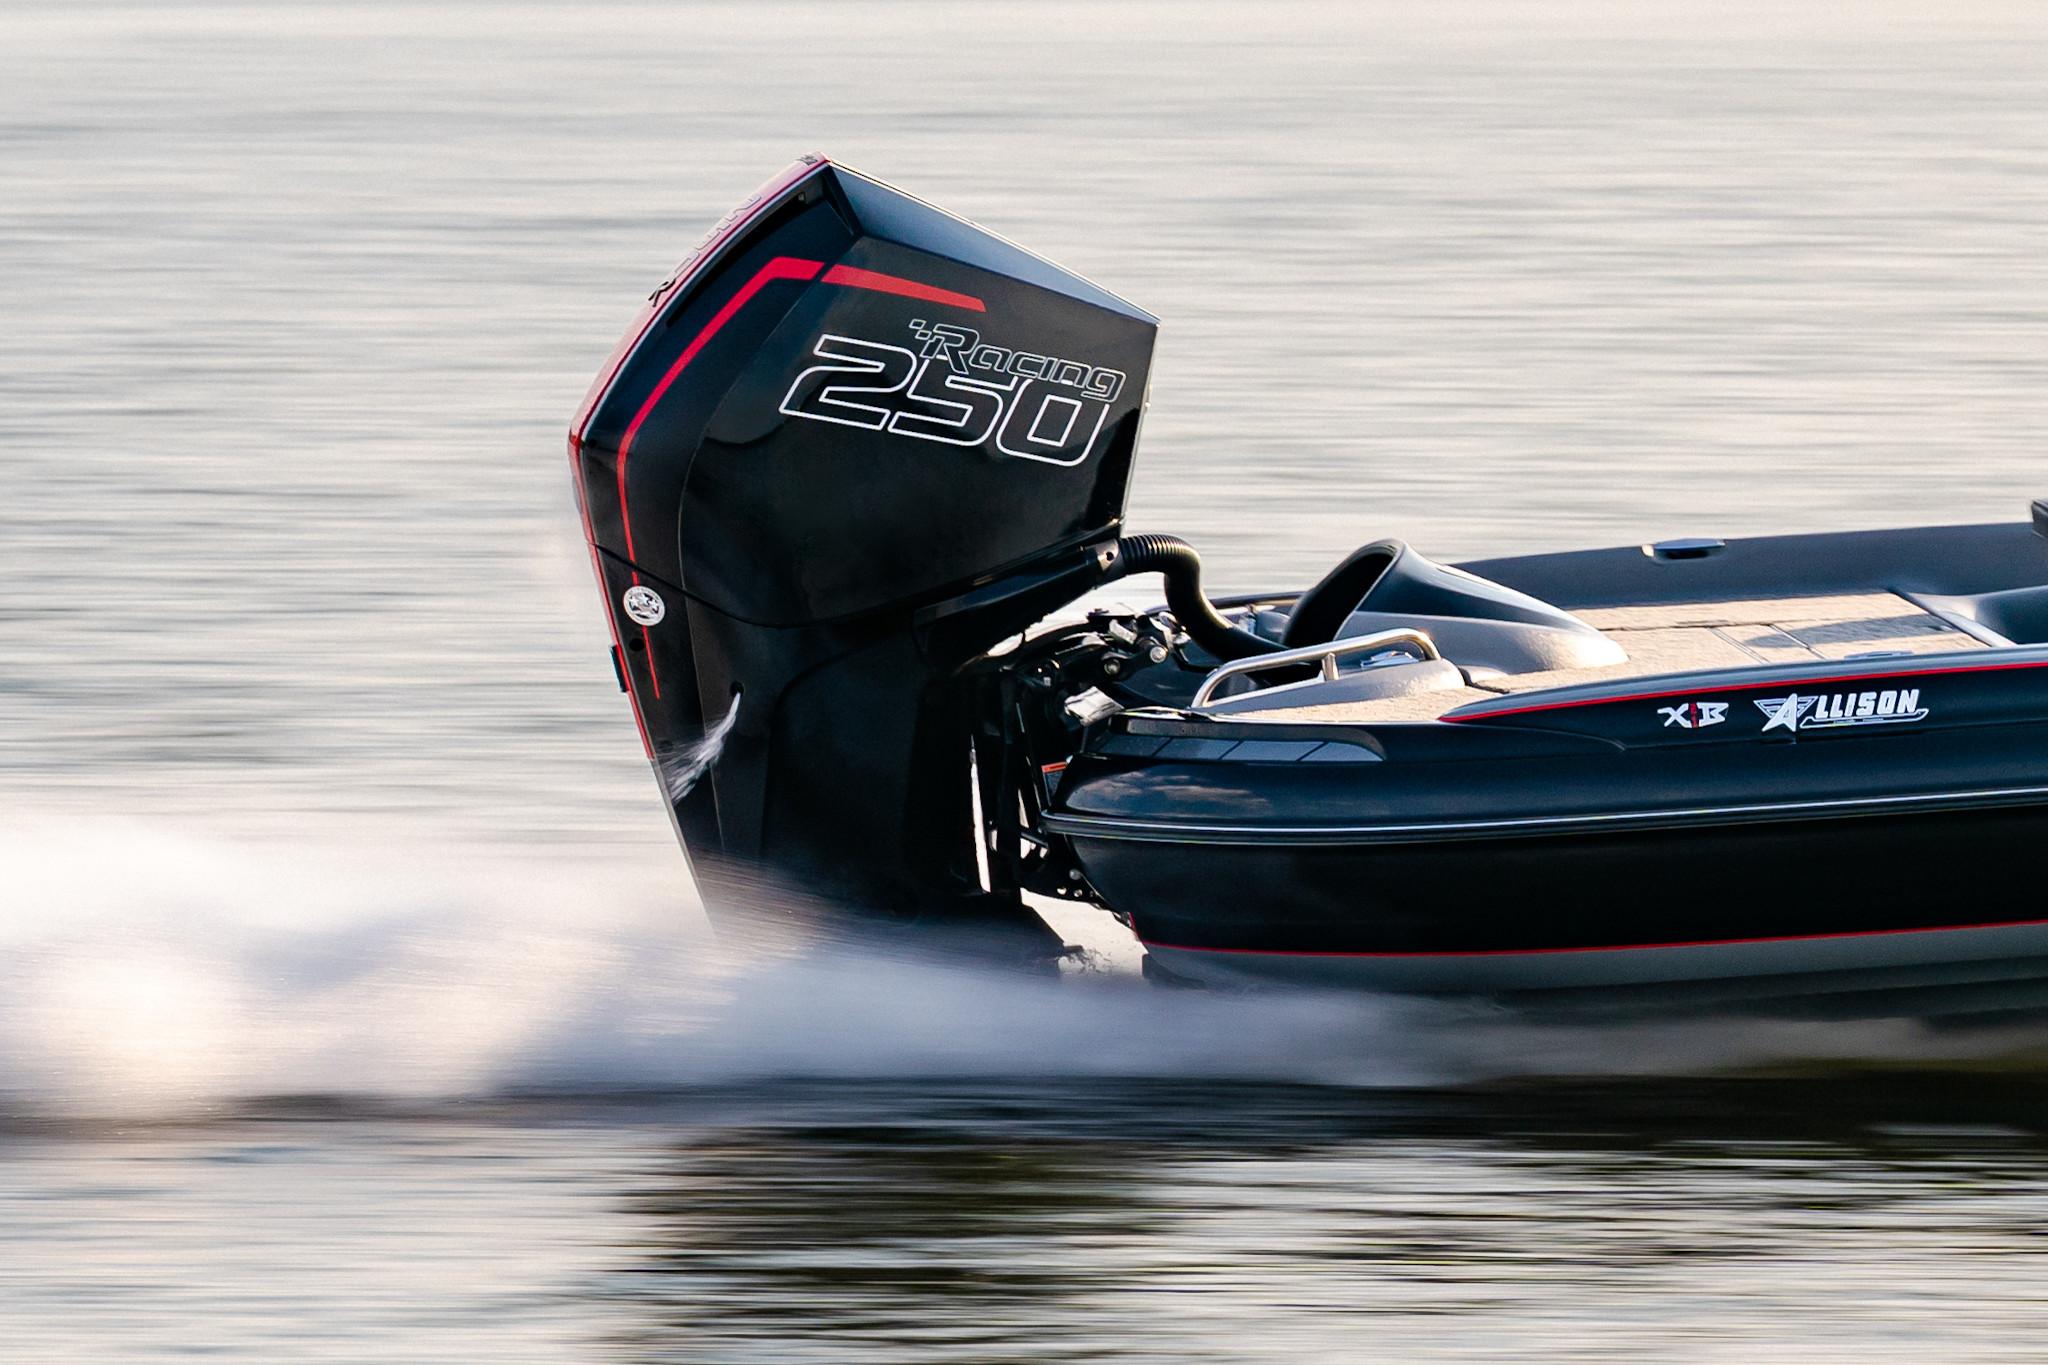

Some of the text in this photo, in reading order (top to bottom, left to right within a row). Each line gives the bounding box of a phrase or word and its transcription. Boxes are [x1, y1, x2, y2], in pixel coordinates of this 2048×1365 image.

[778, 333, 1111, 467] 250
[911, 319, 1127, 403] Racing
[1760, 689, 1920, 732] ALLISON
